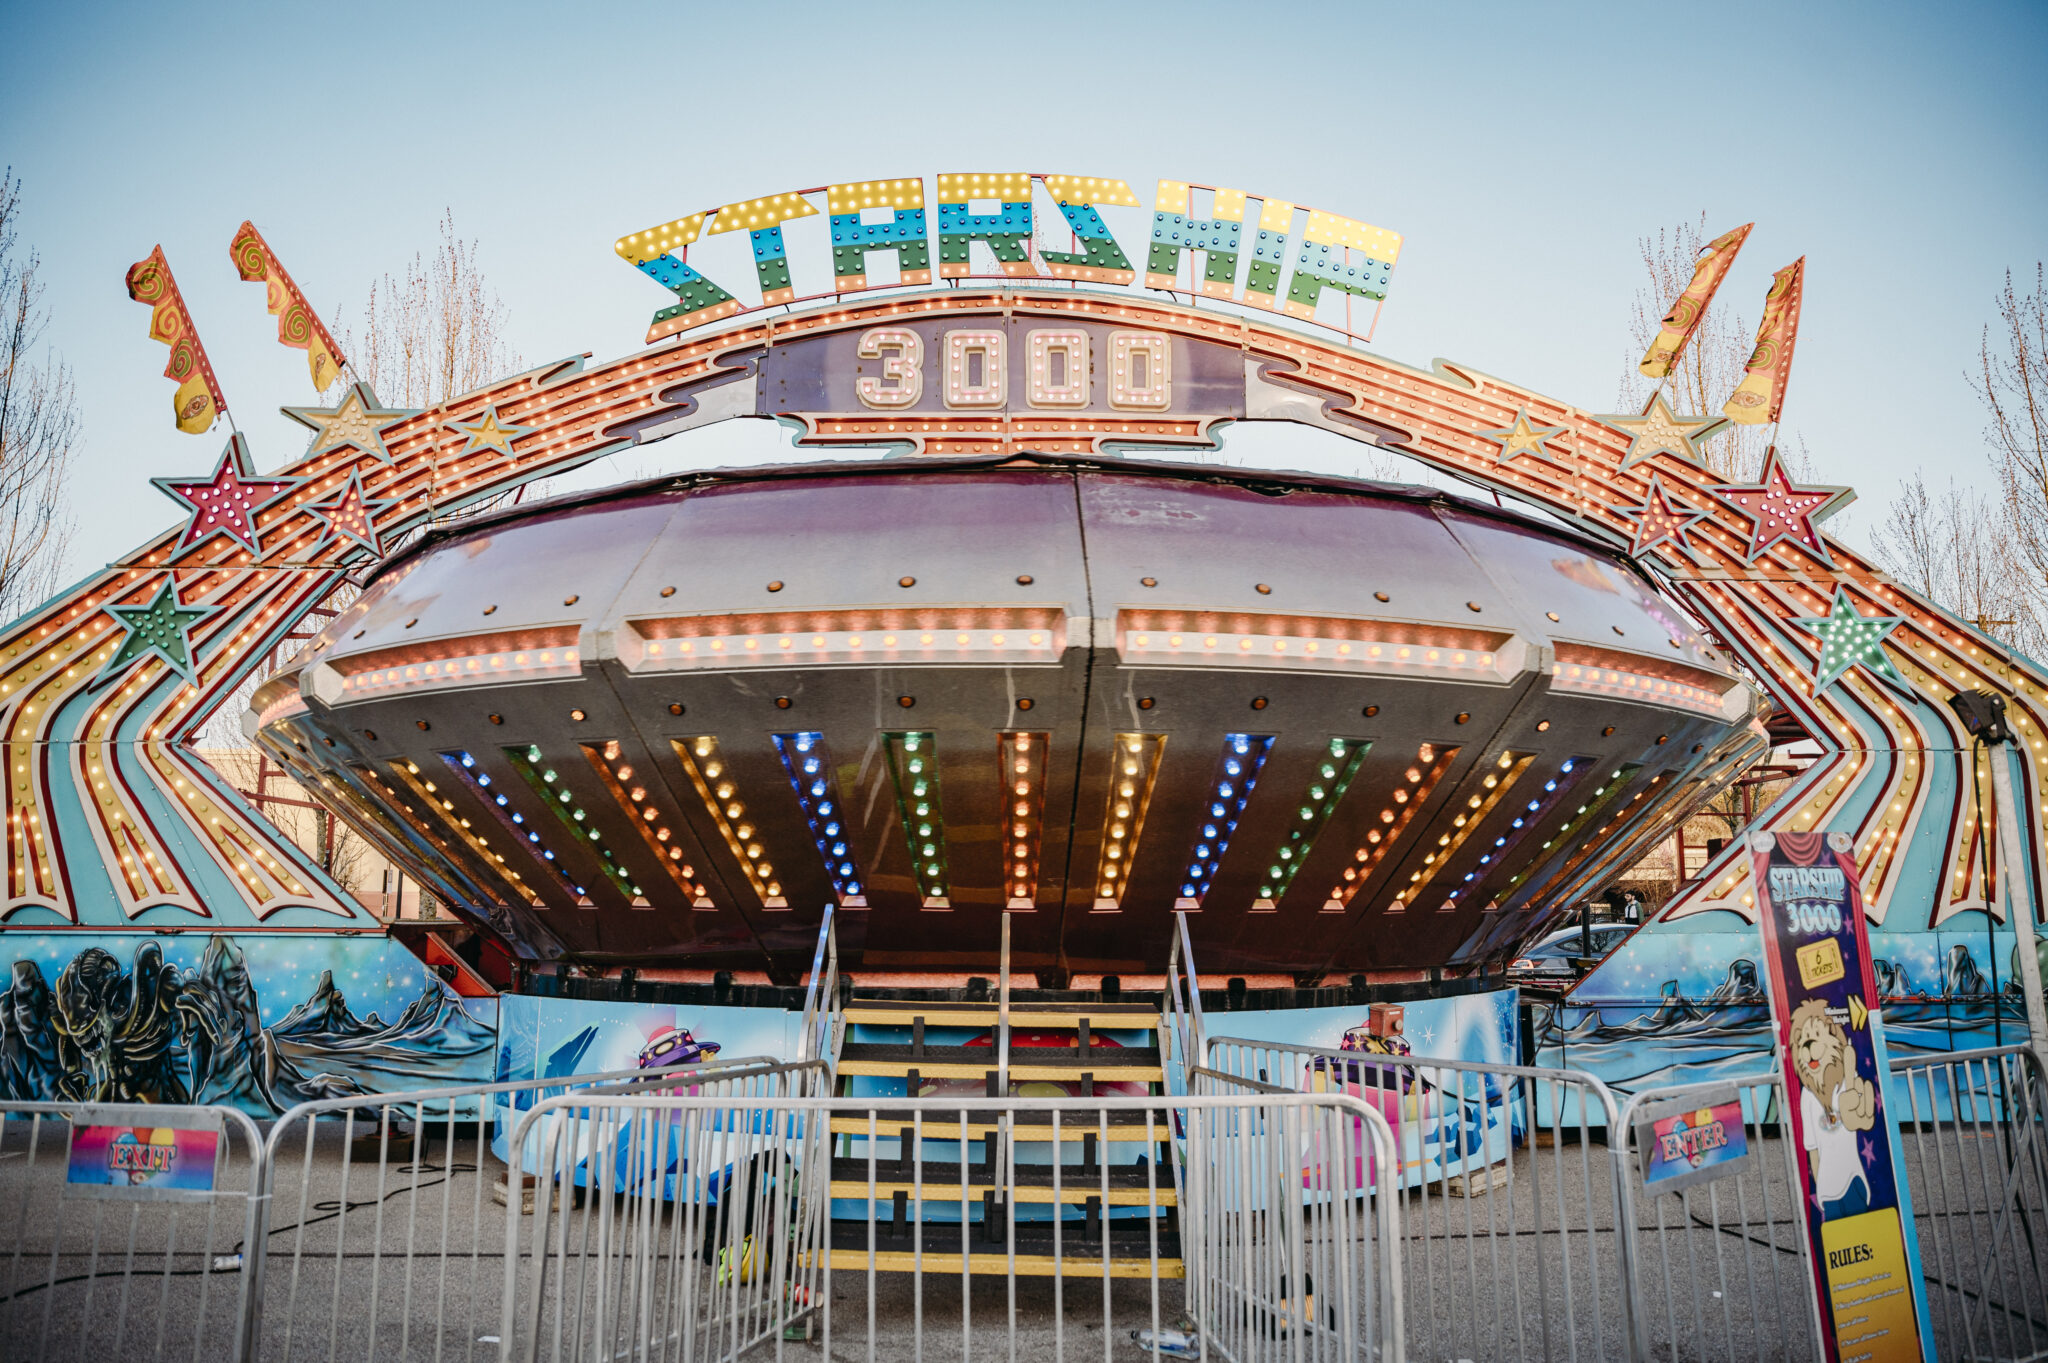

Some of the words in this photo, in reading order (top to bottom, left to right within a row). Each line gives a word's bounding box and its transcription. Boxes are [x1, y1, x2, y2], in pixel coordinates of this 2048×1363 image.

[614, 172, 1403, 344] STARSHIP
[855, 327, 1173, 412] 3000
[1769, 866, 1845, 903] STARSHIP
[1785, 902, 1842, 934] 3000
[1811, 962, 1834, 977] TICKETS
[1815, 949, 1822, 966] 6
[110, 1143, 178, 1171] EXIT
[1660, 1121, 1729, 1164] ENTER
[1828, 1243, 1874, 1270] RULES:
